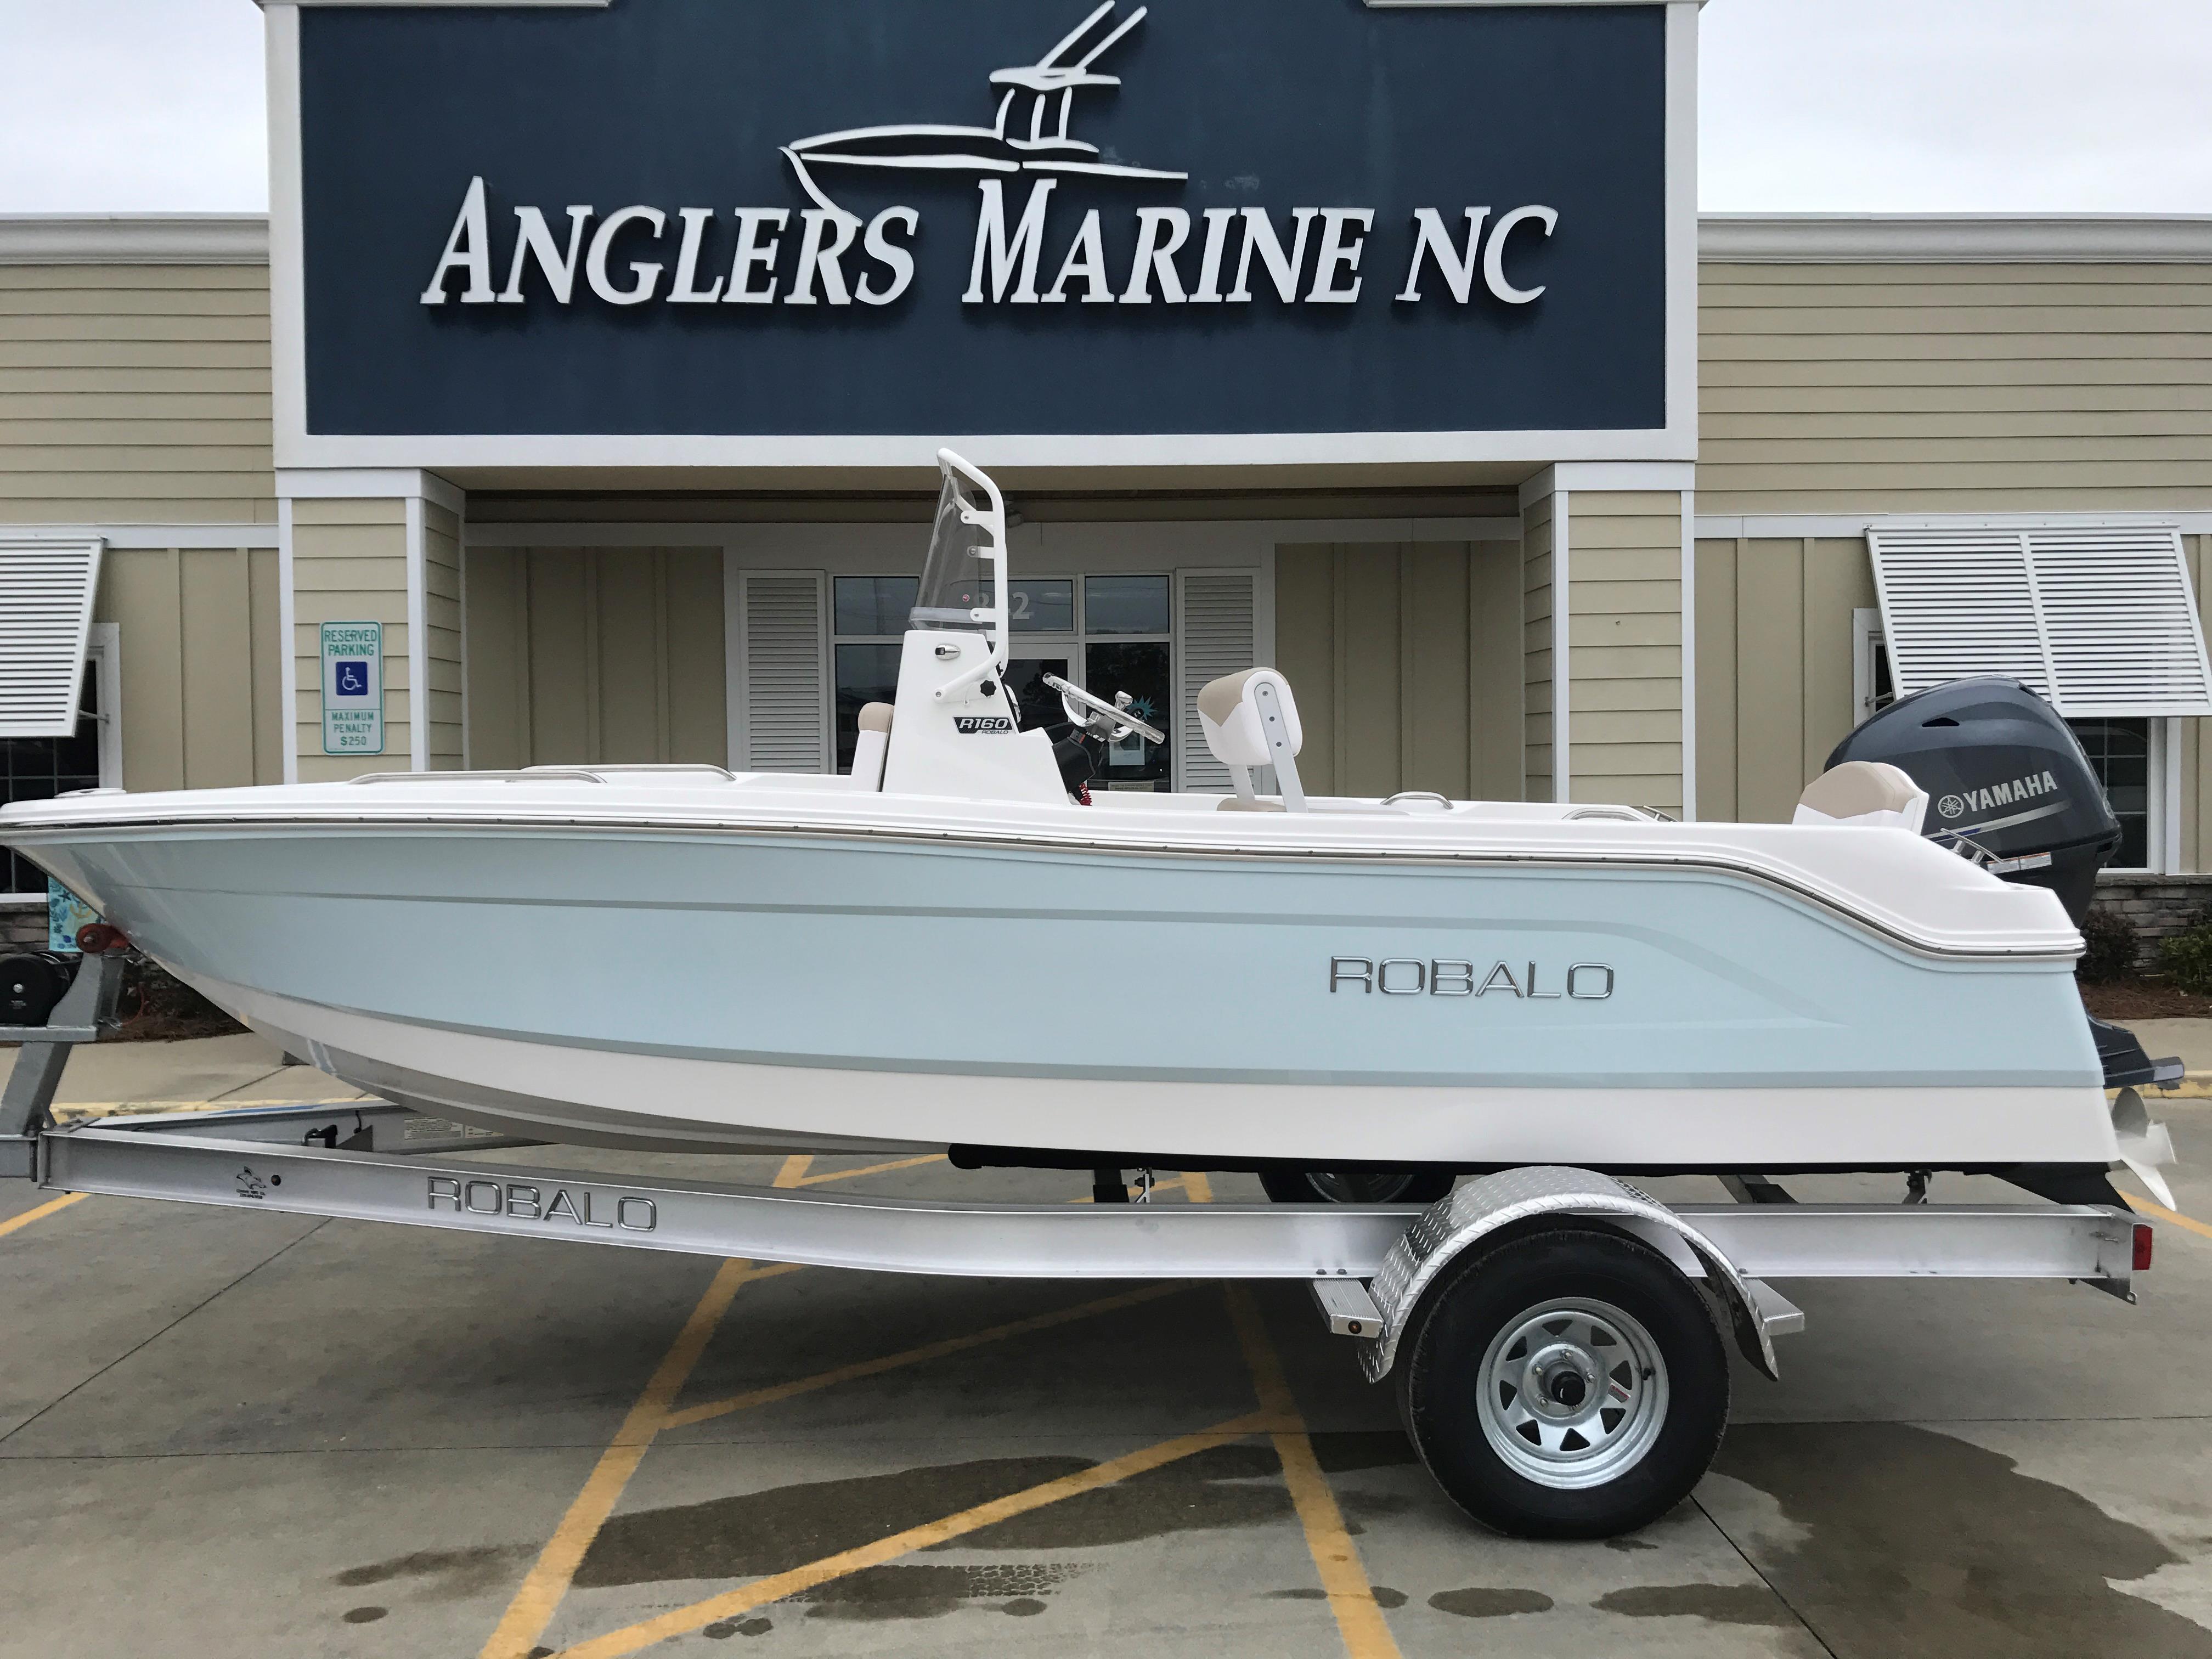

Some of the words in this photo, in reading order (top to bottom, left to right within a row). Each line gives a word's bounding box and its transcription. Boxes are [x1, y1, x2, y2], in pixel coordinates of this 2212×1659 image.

[420, 176, 919, 305] ANGLERS
[961, 178, 1375, 304] MARINE
[1395, 204, 1559, 304] NC
[324, 630, 377, 642] RESERVED
[328, 644, 375, 656] PARKING
[331, 712, 375, 721] MAXIMUM
[333, 724, 372, 733] PENALTY
[959, 718, 1008, 729] R160
[340, 736, 367, 746] $250
[1962, 770, 2058, 812] YAMAHA
[1329, 956, 1615, 1000] ROBALO
[427, 1176, 657, 1233] ROBALO
